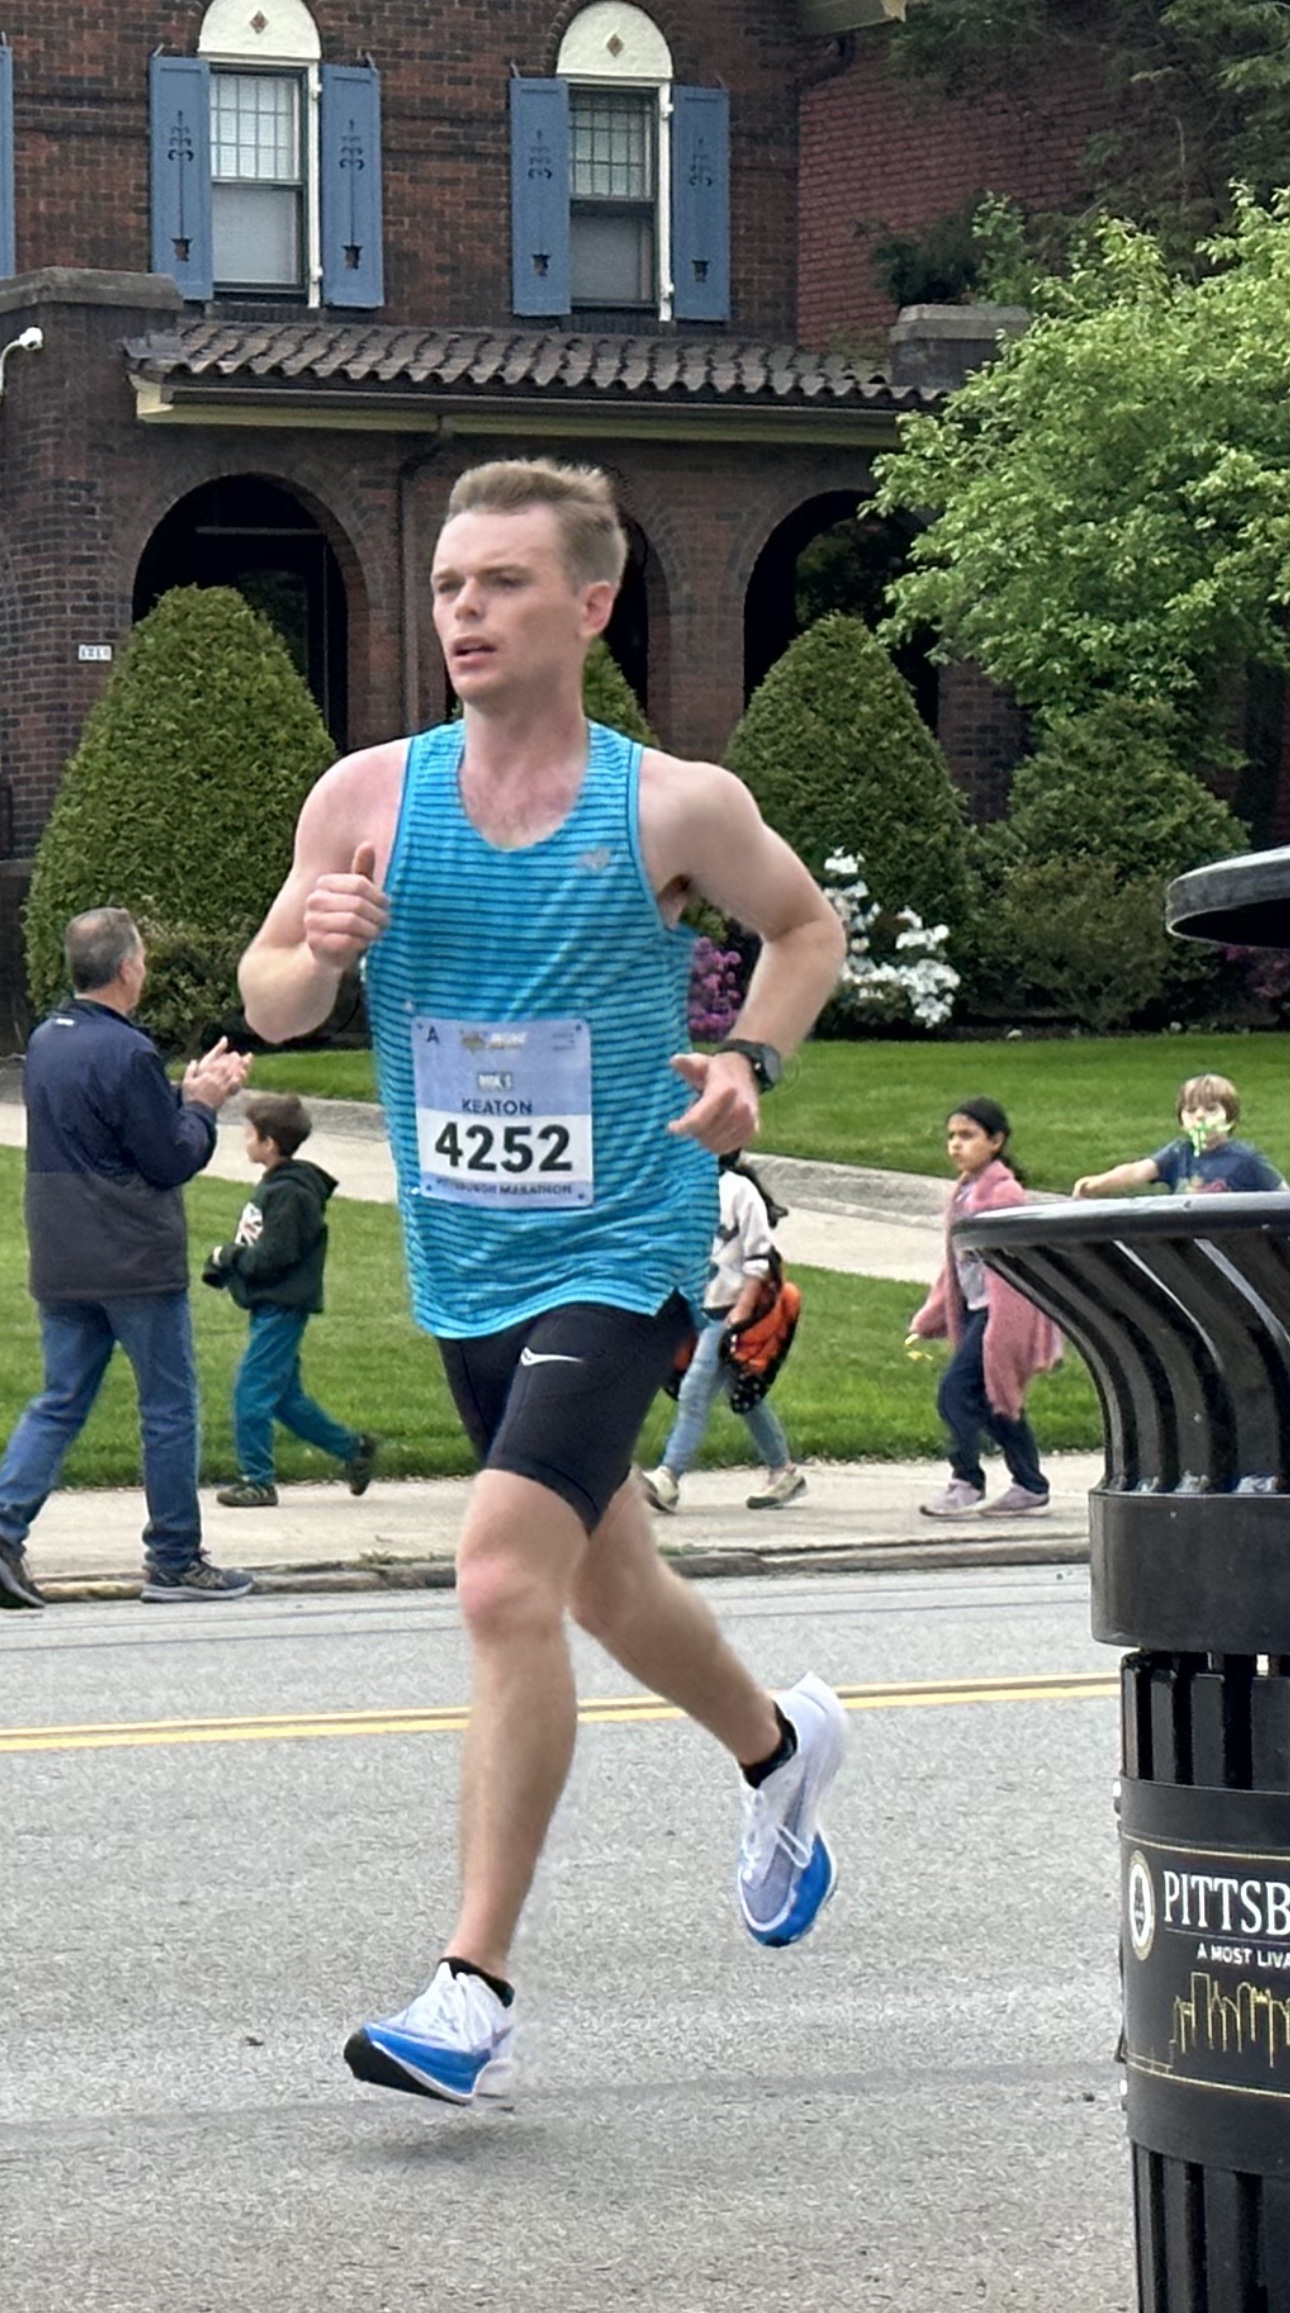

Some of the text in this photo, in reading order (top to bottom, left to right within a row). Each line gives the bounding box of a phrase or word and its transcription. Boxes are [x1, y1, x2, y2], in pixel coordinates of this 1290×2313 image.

[426, 1026, 439, 1044] A
[462, 1098, 533, 1116] KEATON
[434, 1121, 573, 1174] 4252
[500, 1183, 572, 1195] MARATHON
[1163, 1870, 1290, 1936] PITTSB
[1197, 1941, 1208, 1960] A
[1211, 1943, 1254, 1965] MOST
